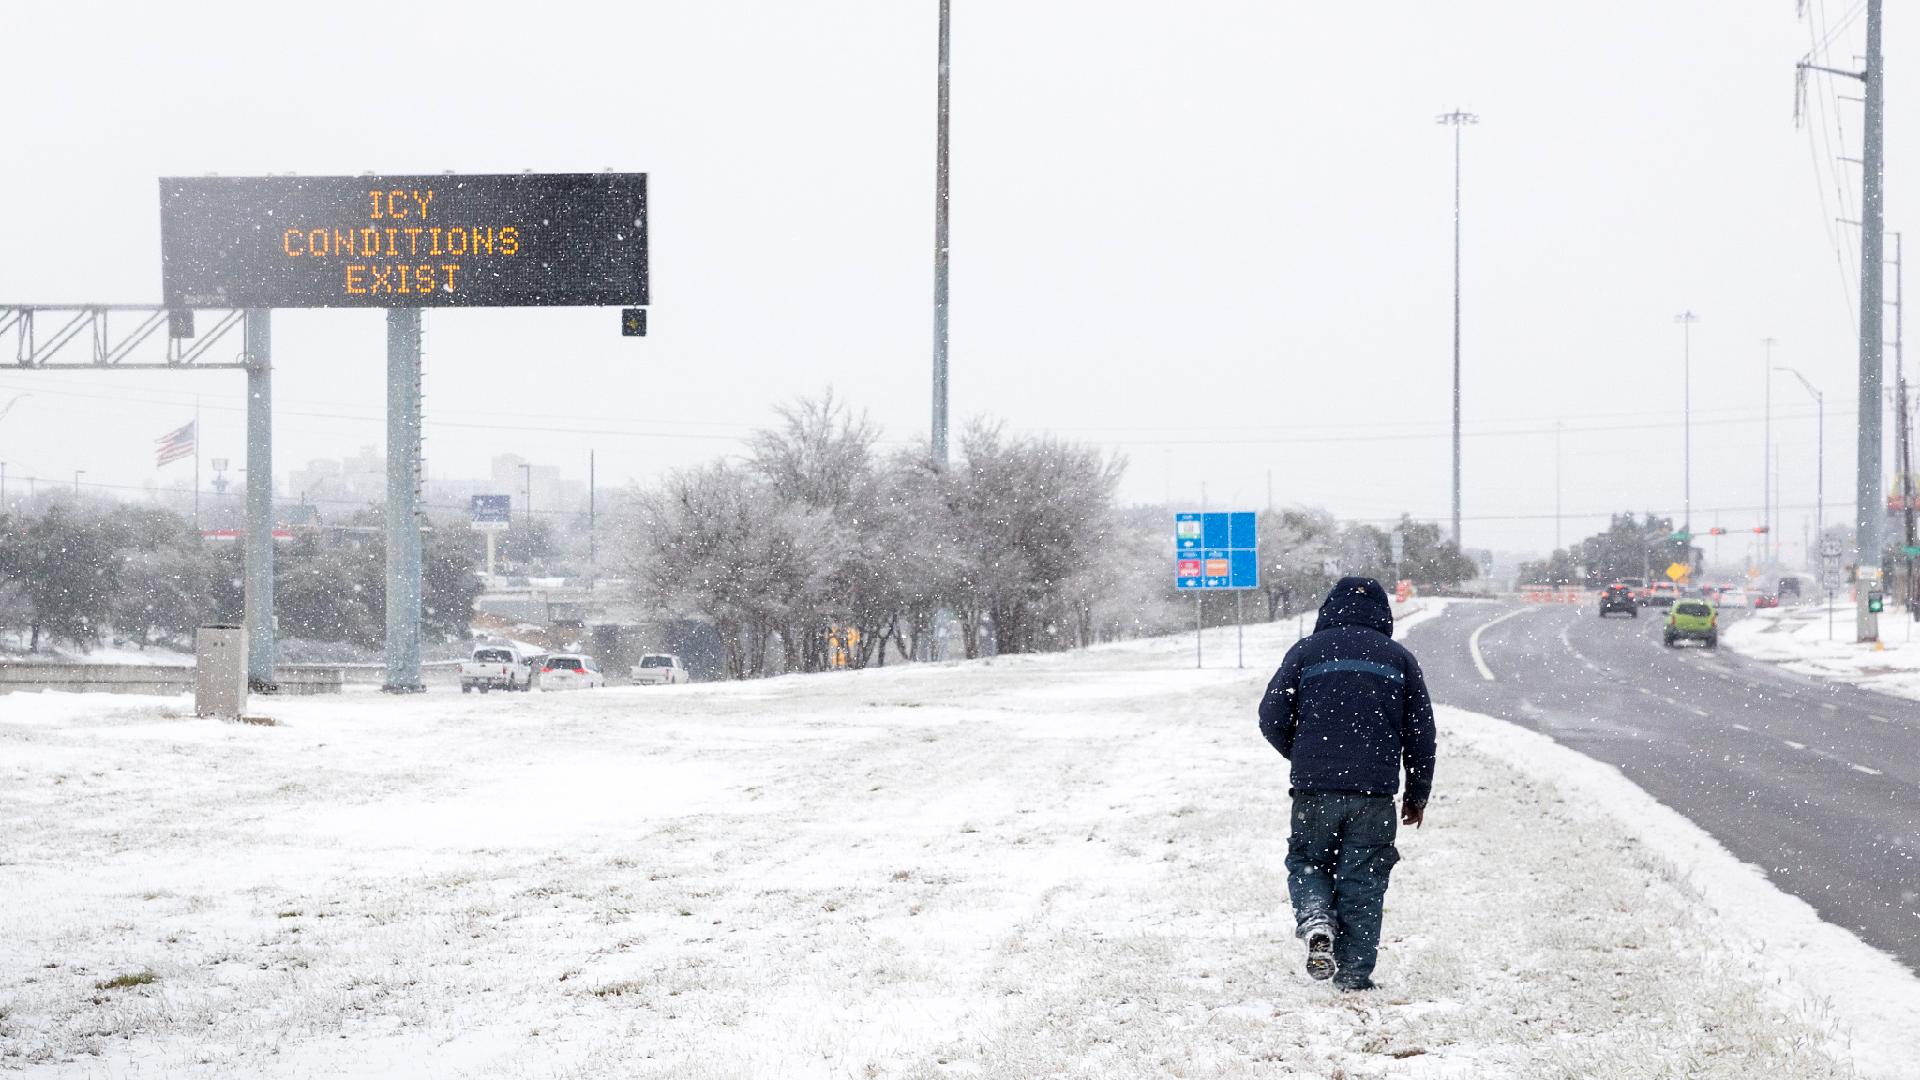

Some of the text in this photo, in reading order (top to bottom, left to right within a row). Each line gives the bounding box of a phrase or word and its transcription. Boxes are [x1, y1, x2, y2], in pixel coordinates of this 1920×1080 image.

[369, 190, 434, 219] ICY
[283, 226, 520, 257] CONDITIONS
[345, 263, 460, 294] EXIST
